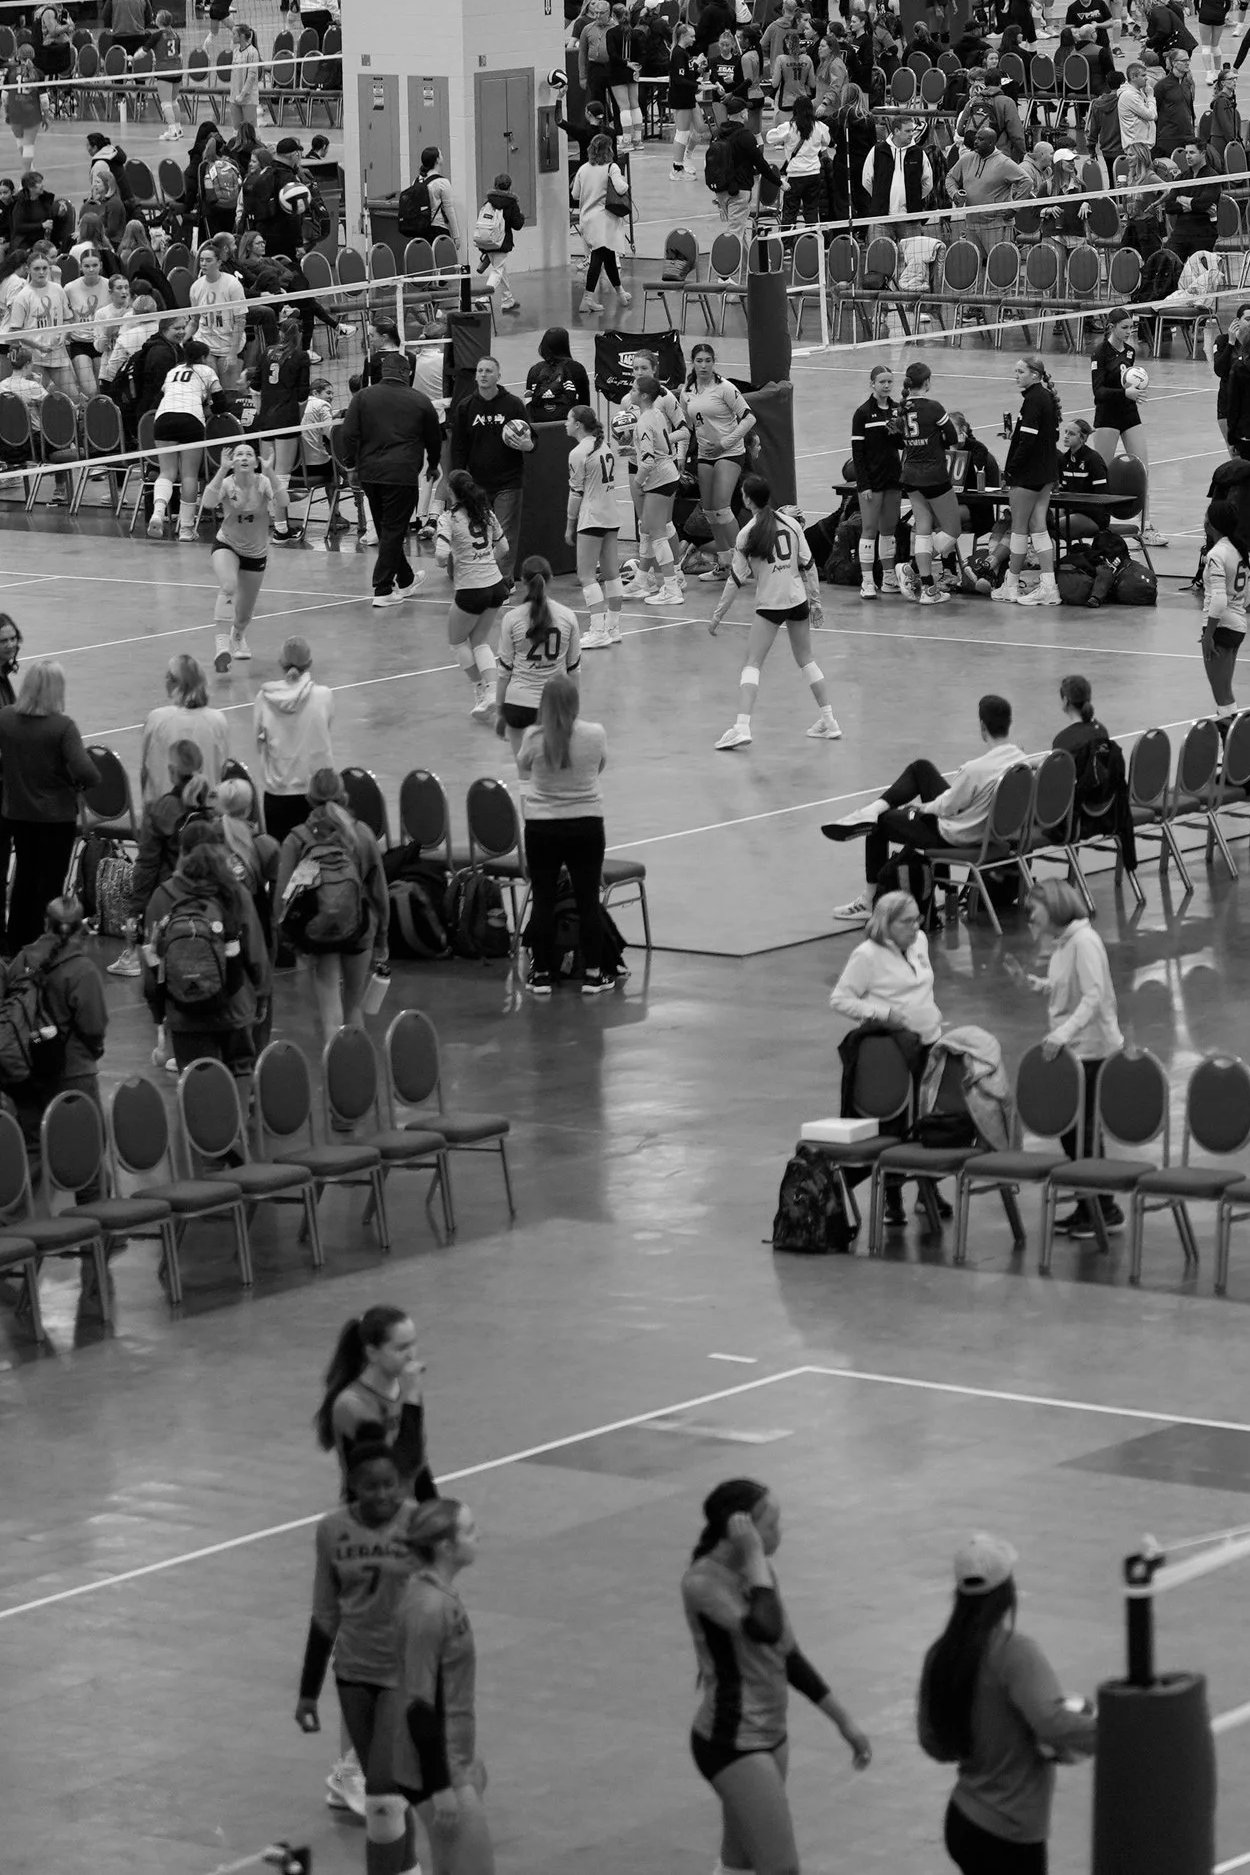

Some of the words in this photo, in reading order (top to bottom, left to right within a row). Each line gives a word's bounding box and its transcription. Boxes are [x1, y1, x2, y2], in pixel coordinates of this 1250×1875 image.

[167, 40, 176, 57] 3
[171, 370, 194, 383] 10
[269, 362, 280, 384] 3
[240, 409, 257, 427] 5
[696, 411, 704, 425] 4
[600, 452, 615, 484] 12
[1234, 560, 1247, 593] 6
[362, 1564, 381, 1596] 7
